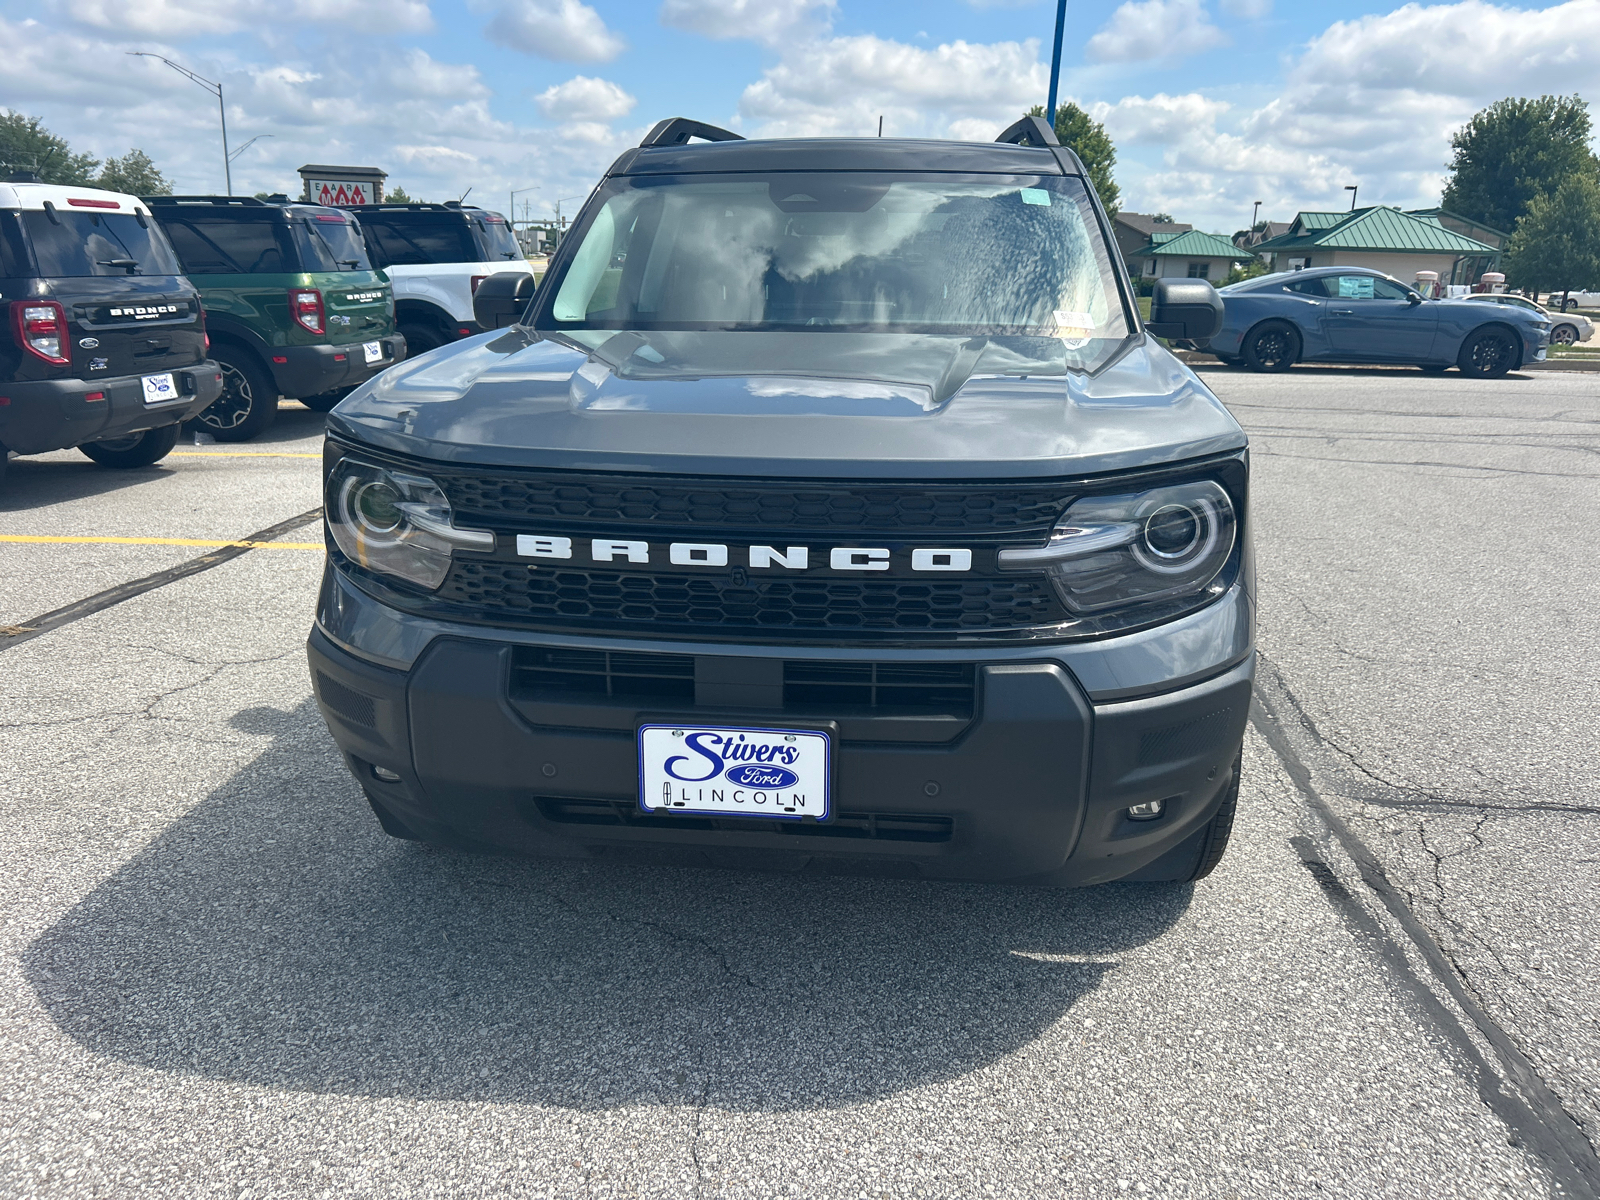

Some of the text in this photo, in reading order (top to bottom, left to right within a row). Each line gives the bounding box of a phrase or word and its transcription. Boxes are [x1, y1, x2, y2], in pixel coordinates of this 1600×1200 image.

[315, 183, 367, 193] EARL
[321, 193, 361, 205] MAY
[346, 292, 382, 300] BRONCO
[110, 305, 177, 316] BRONCO
[516, 534, 972, 571] BRONCO
[664, 732, 800, 781] Stivers
[740, 766, 783, 786] Ford
[682, 788, 806, 807] LINCOLN
